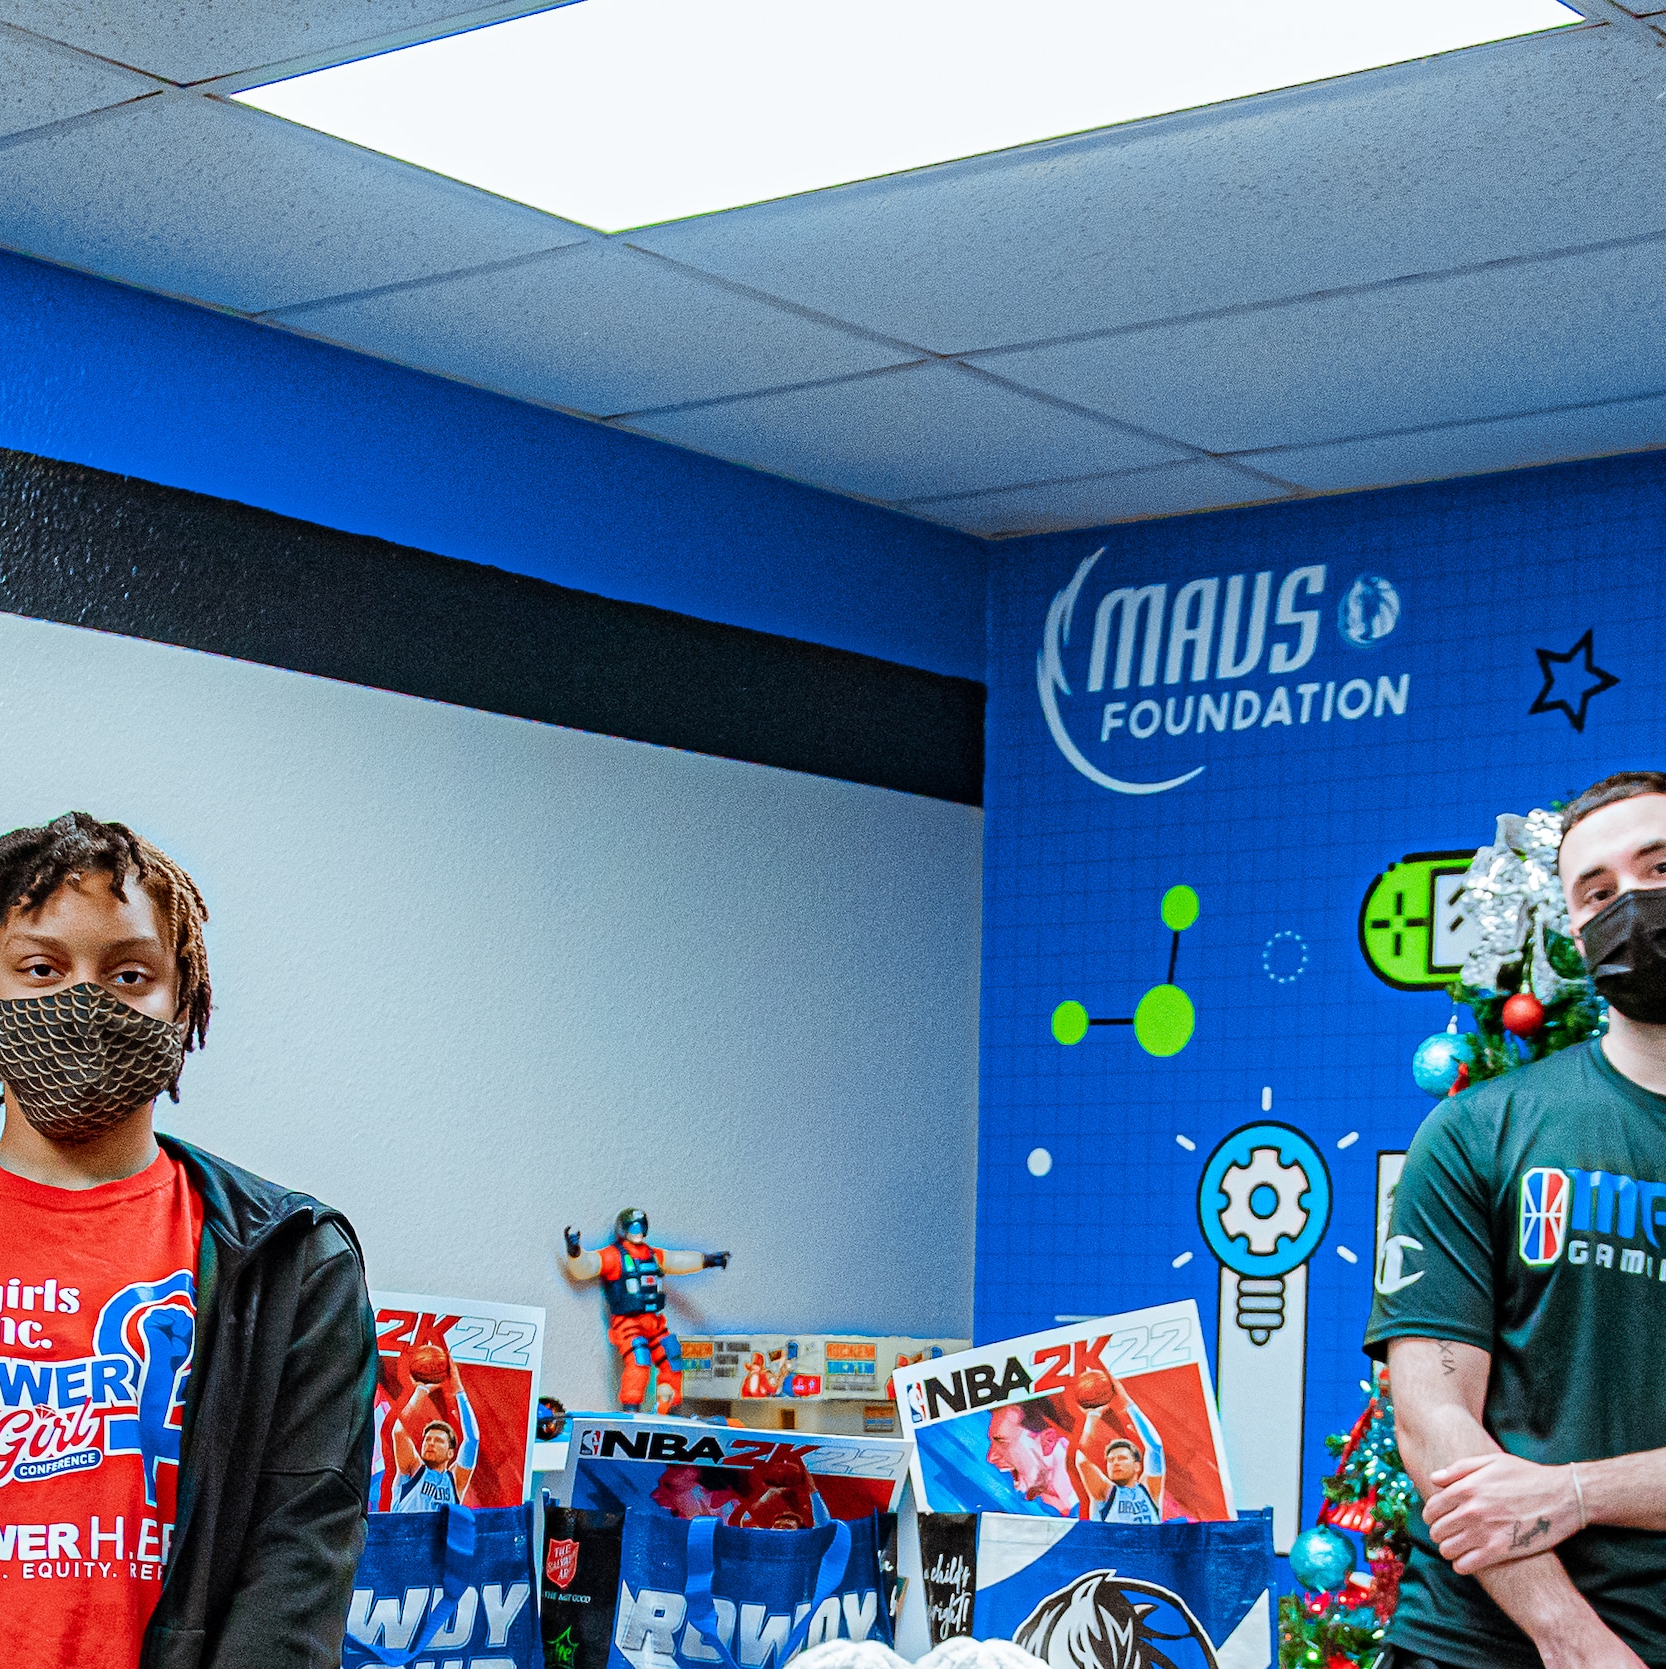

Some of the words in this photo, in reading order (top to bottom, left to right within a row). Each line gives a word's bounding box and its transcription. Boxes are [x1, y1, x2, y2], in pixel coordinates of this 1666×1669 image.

[1087, 564, 1326, 693] MAVS
[1100, 673, 1411, 742] FOUNDATION
[19, 1452, 96, 1478] CONFERENCE
[22, 1562, 118, 1580] EQUITY.
[346, 1581, 530, 1651] WDY
